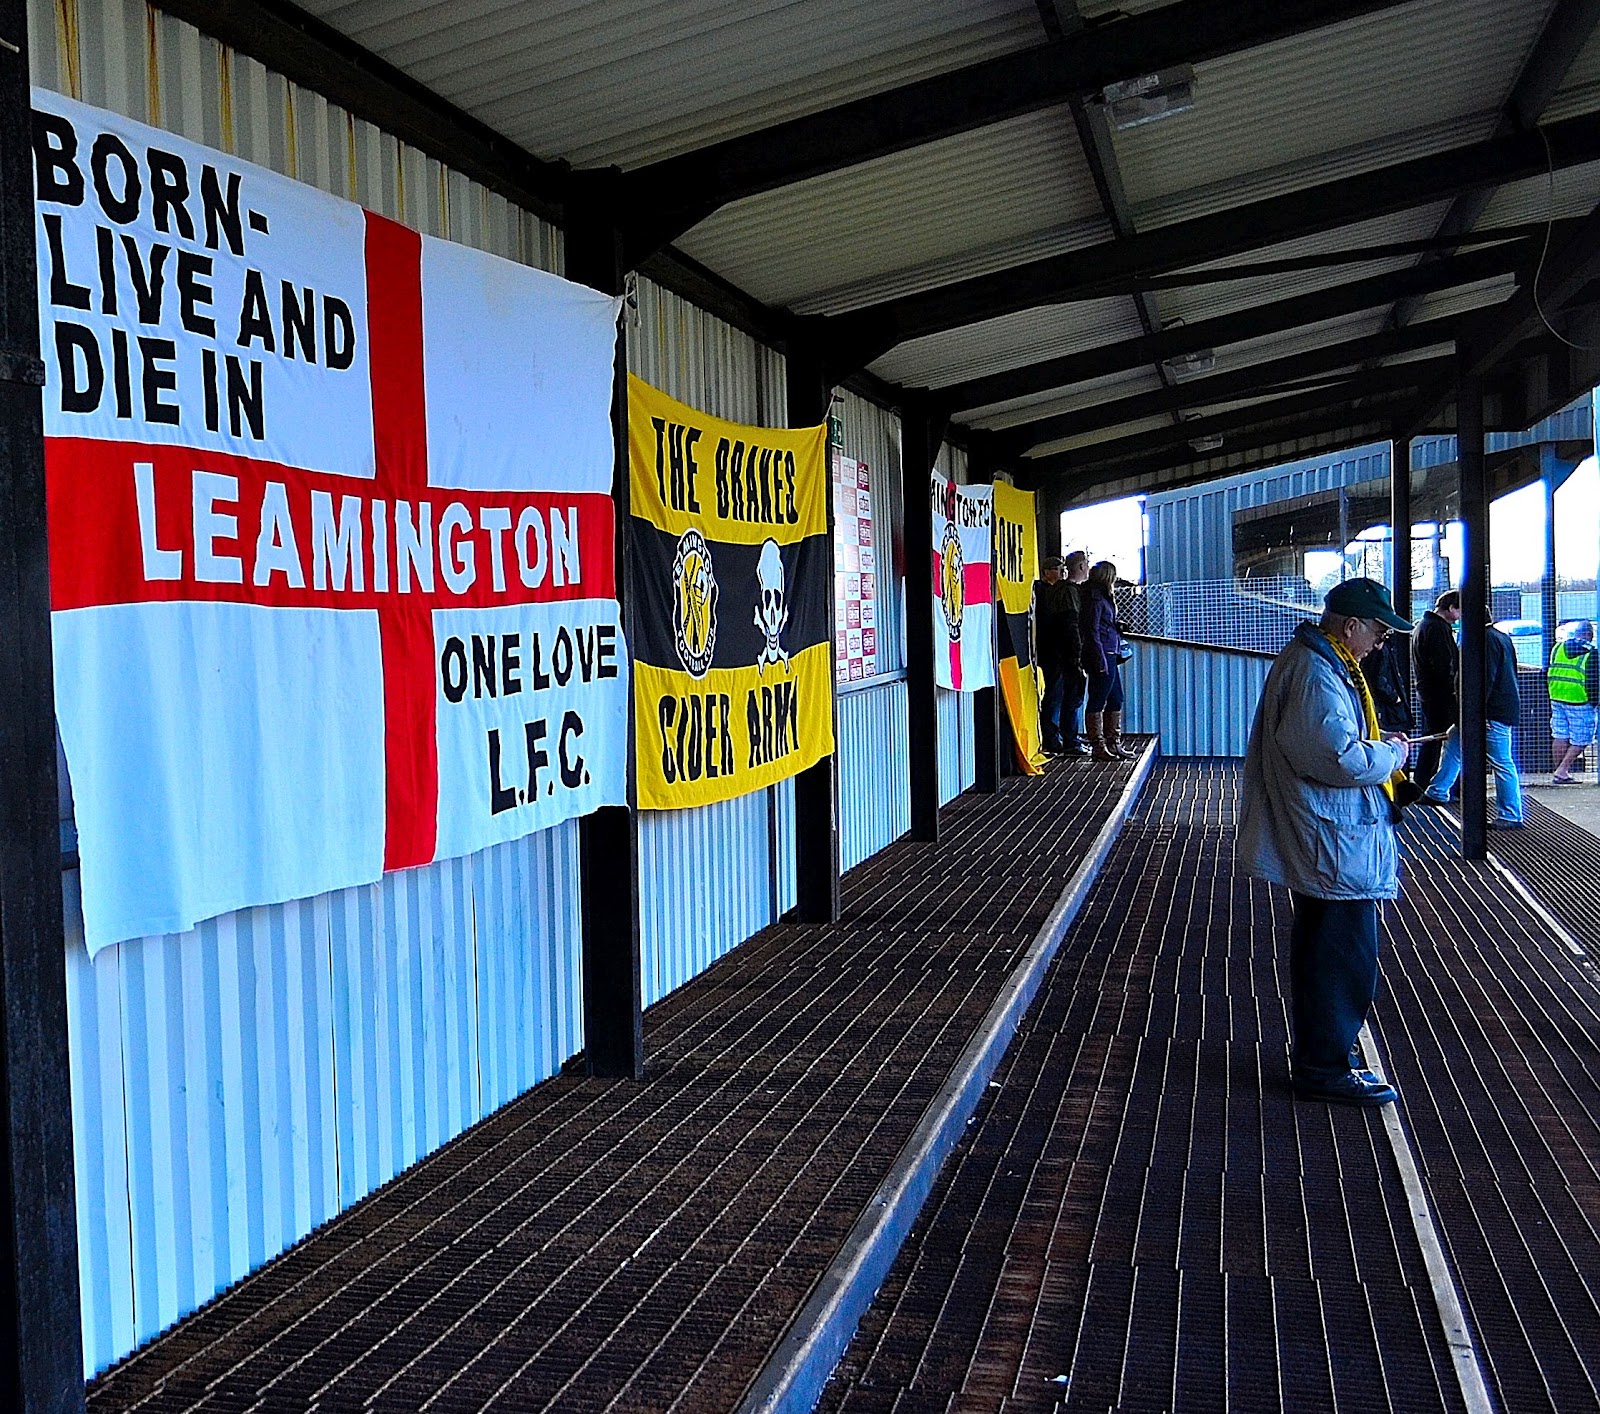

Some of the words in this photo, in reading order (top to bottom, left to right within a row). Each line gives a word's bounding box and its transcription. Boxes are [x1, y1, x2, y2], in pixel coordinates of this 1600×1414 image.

[42, 213, 217, 339] LIVE
[236, 268, 356, 371] AND
[54, 320, 181, 427] DIE
[201, 347, 265, 441] IN
[133, 462, 581, 594] LEAMINGTON
[651, 415, 703, 515] THE
[715, 437, 800, 525] BRAKES
[440, 633, 522, 703] ONE
[533, 625, 618, 688] LOVE
[658, 692, 735, 785] CIDER
[746, 674, 800, 770] ARMY
